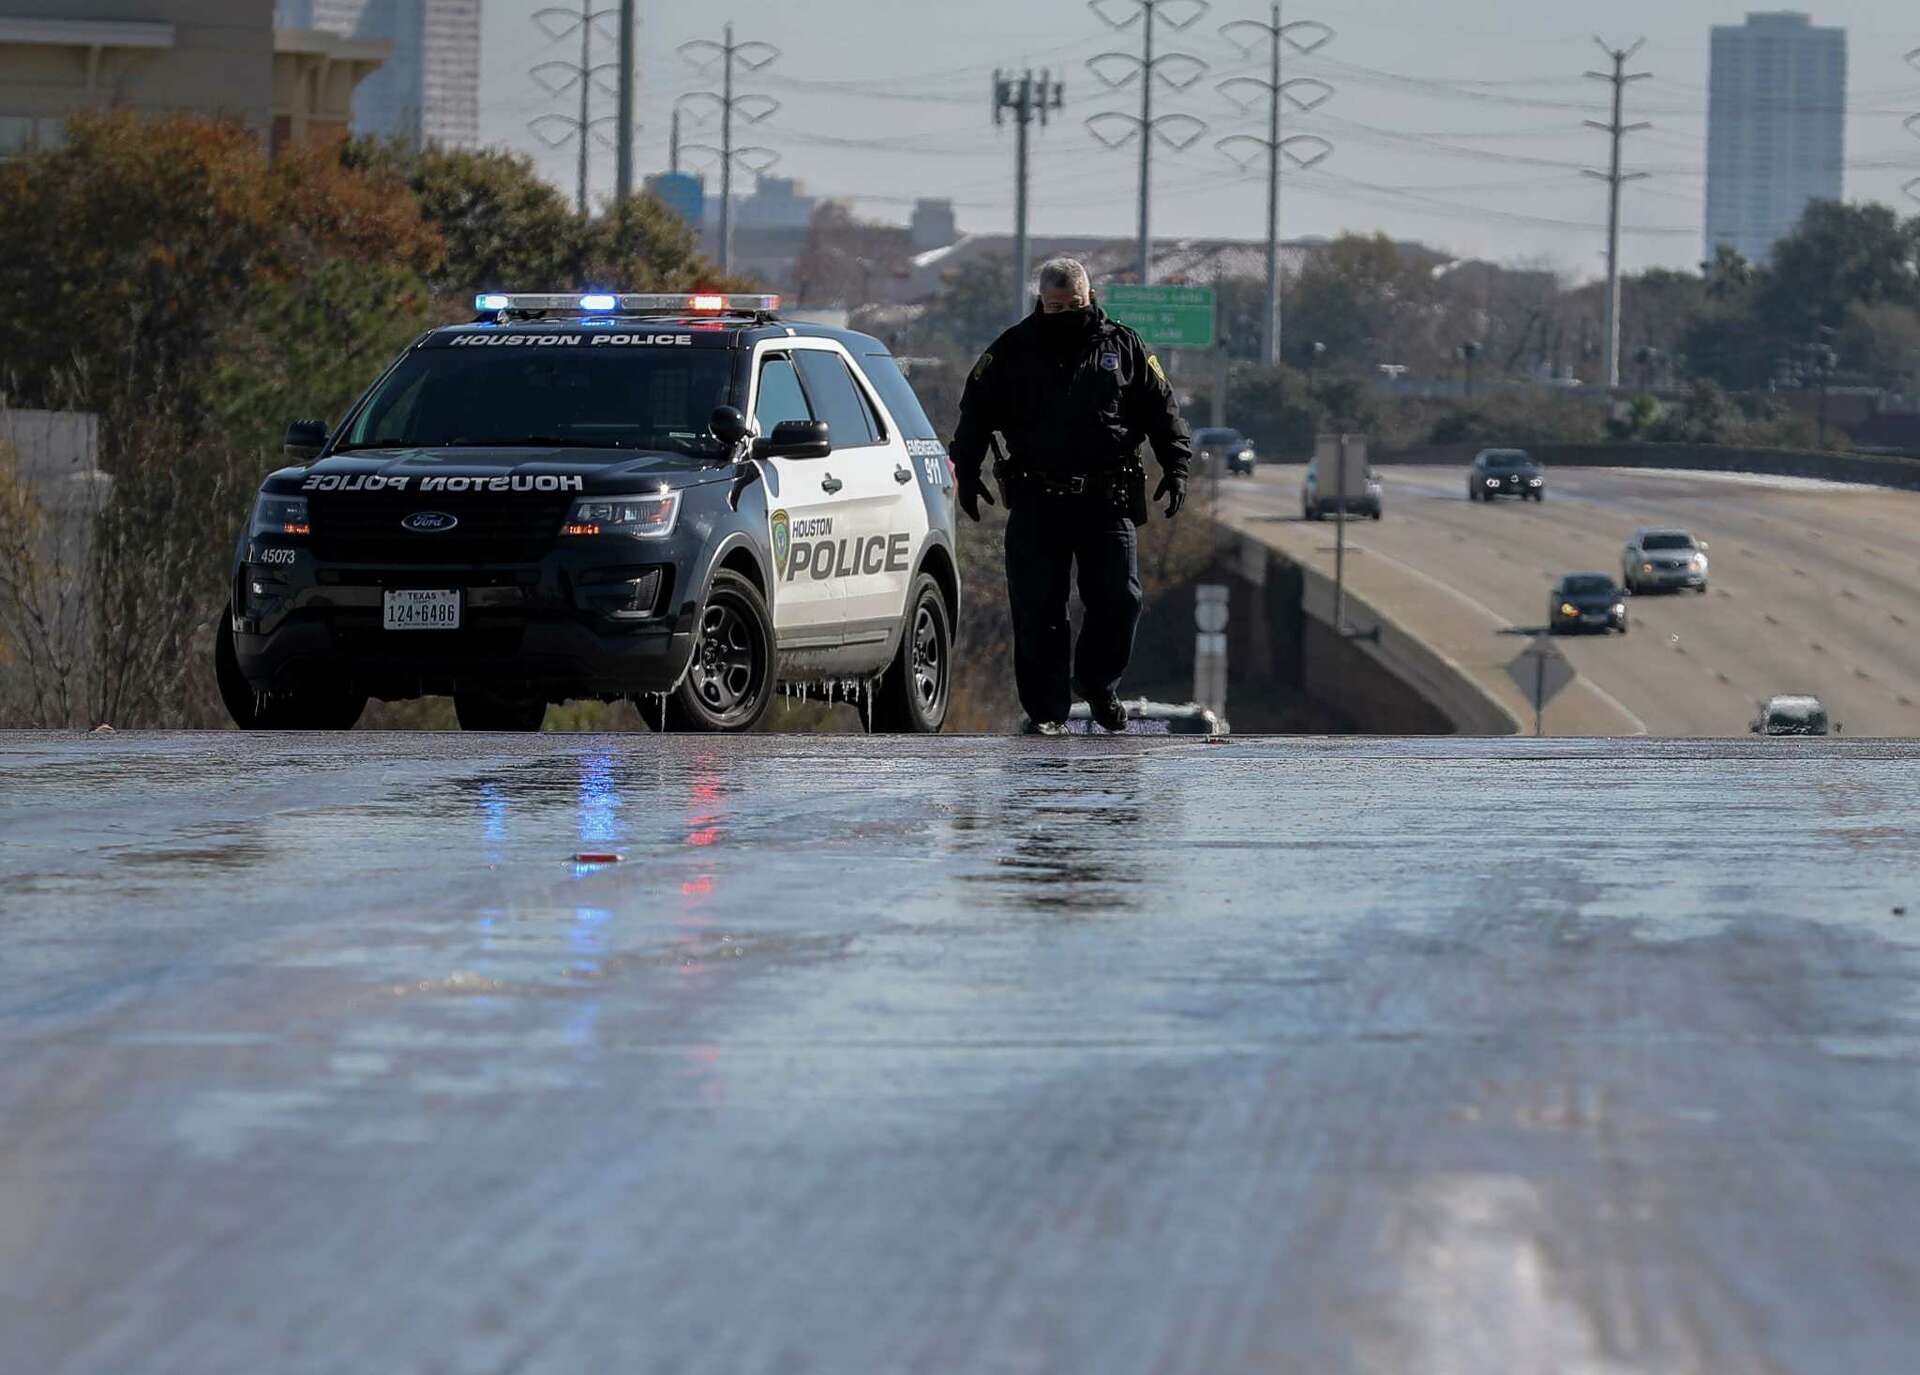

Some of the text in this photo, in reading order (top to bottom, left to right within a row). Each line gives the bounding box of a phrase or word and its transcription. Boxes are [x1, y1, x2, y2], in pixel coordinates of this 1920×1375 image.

[449, 335, 692, 346] HOUSTON POLICE
[924, 457, 942, 484] 911
[413, 514, 445, 527] Ford
[792, 518, 833, 538] HOUSTON
[261, 549, 295, 564] 45073
[786, 533, 910, 581] POLICE
[407, 592, 437, 600] TEXAS
